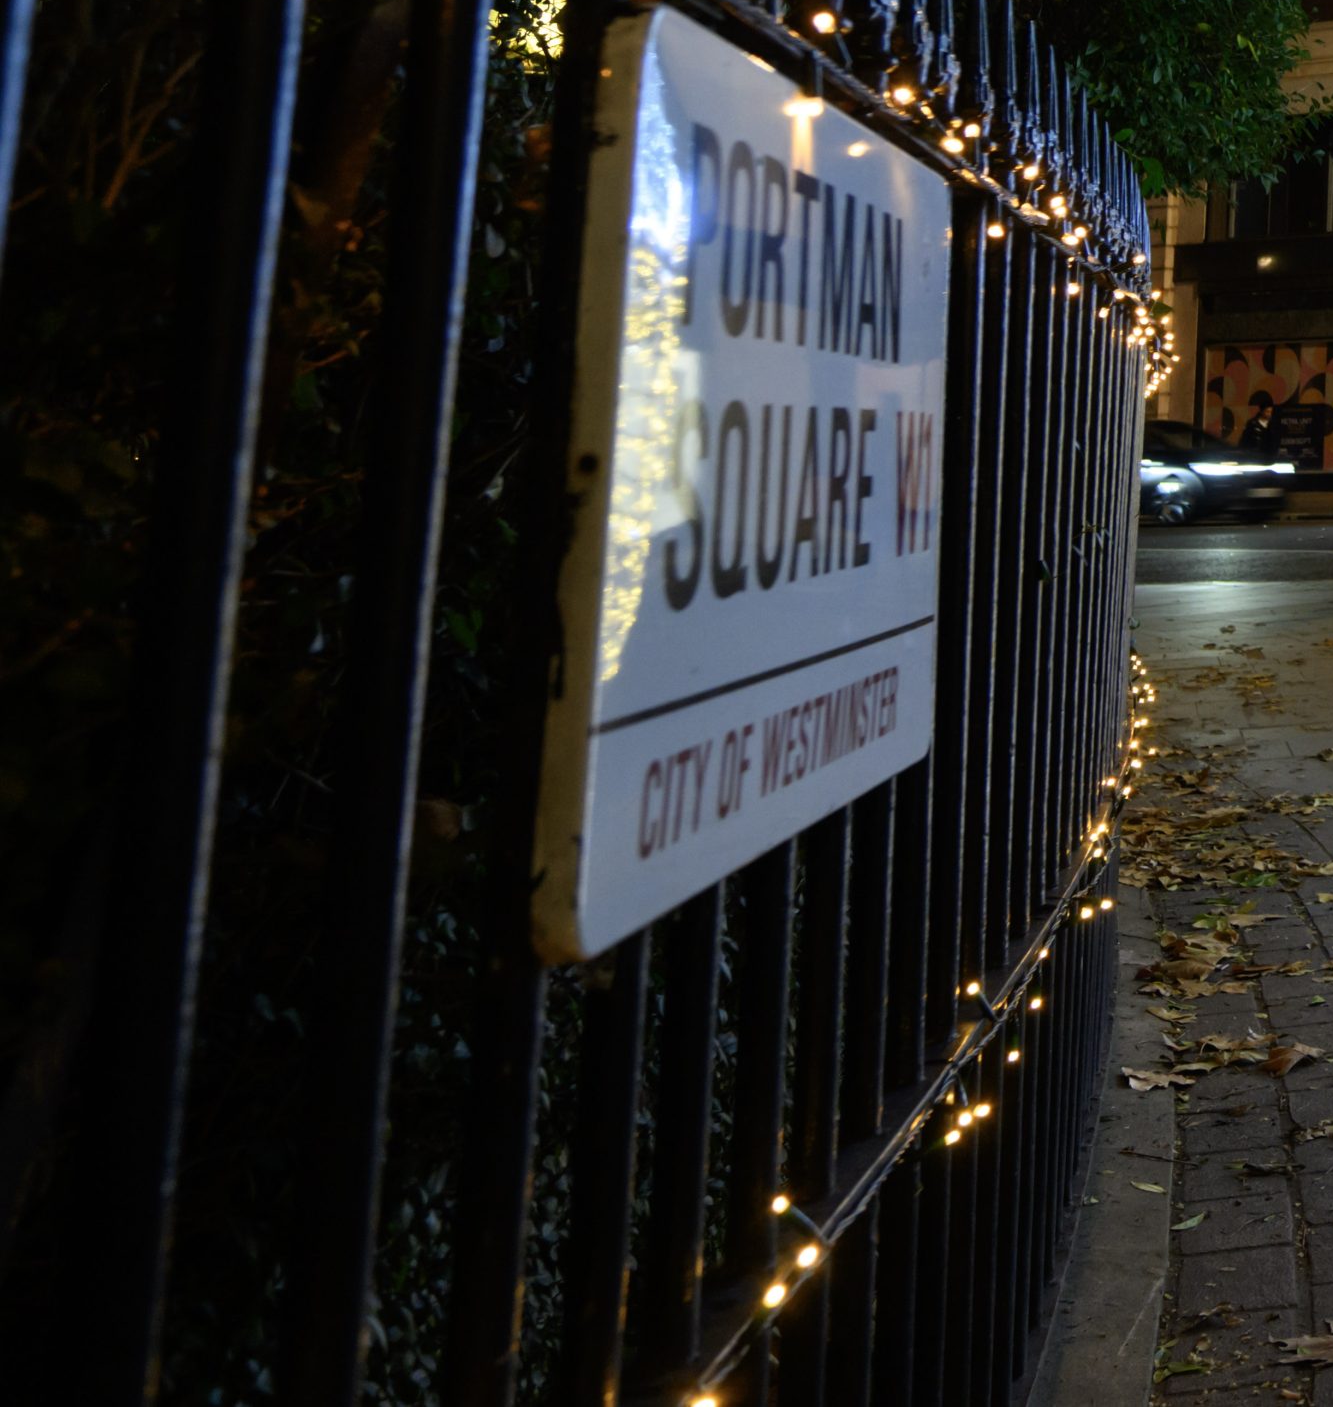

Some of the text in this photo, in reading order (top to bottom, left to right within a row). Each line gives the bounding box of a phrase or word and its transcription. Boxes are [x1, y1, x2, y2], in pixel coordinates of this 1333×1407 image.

[683, 121, 902, 364] PORTMAN
[665, 398, 933, 612] SQUARE W1
[638, 665, 898, 859] CITY OF WESTMINSTER
